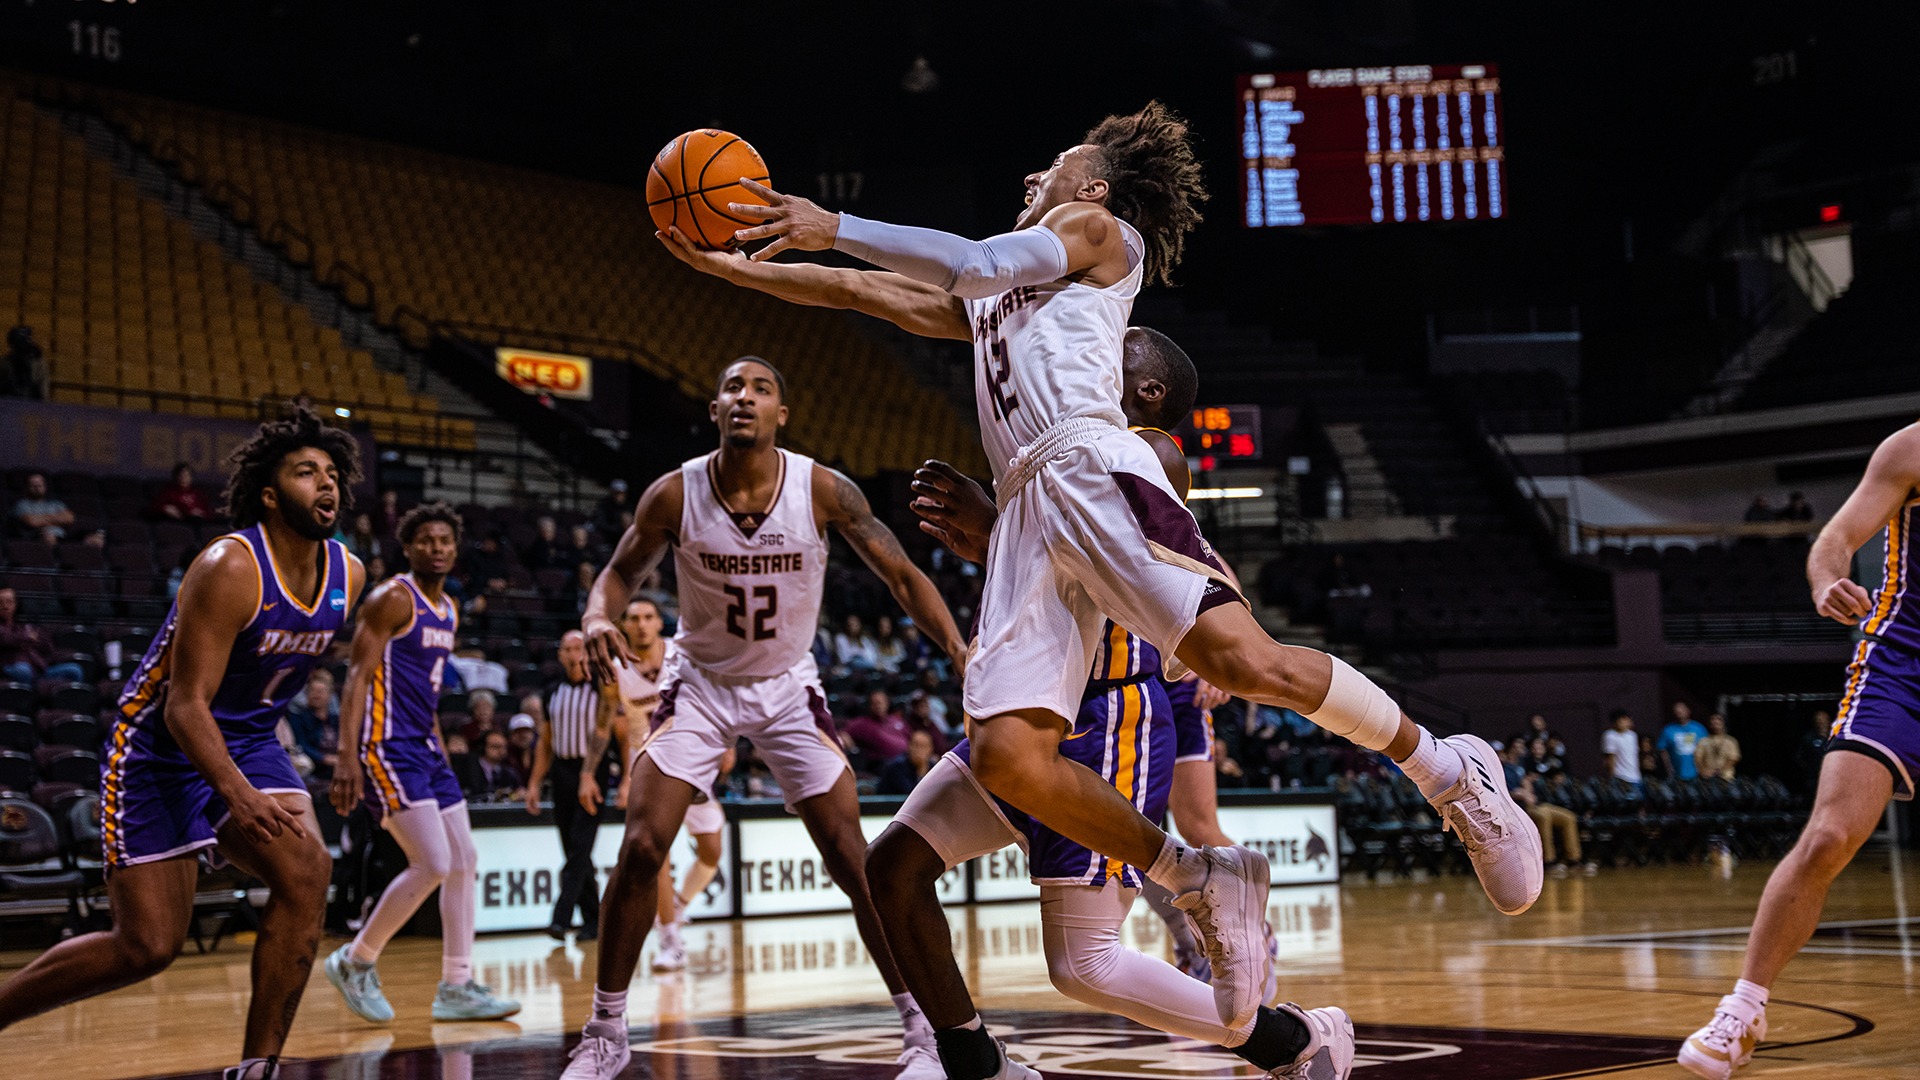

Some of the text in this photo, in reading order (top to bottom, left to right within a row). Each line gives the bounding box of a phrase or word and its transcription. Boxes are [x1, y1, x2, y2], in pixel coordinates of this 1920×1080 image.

[66, 20, 121, 61] 116
[1752, 50, 1797, 86] 201
[816, 172, 864, 201] 117
[20, 411, 118, 465] THE
[723, 583, 777, 641] 22
[429, 656, 444, 693] 4
[475, 869, 562, 907] EXA
